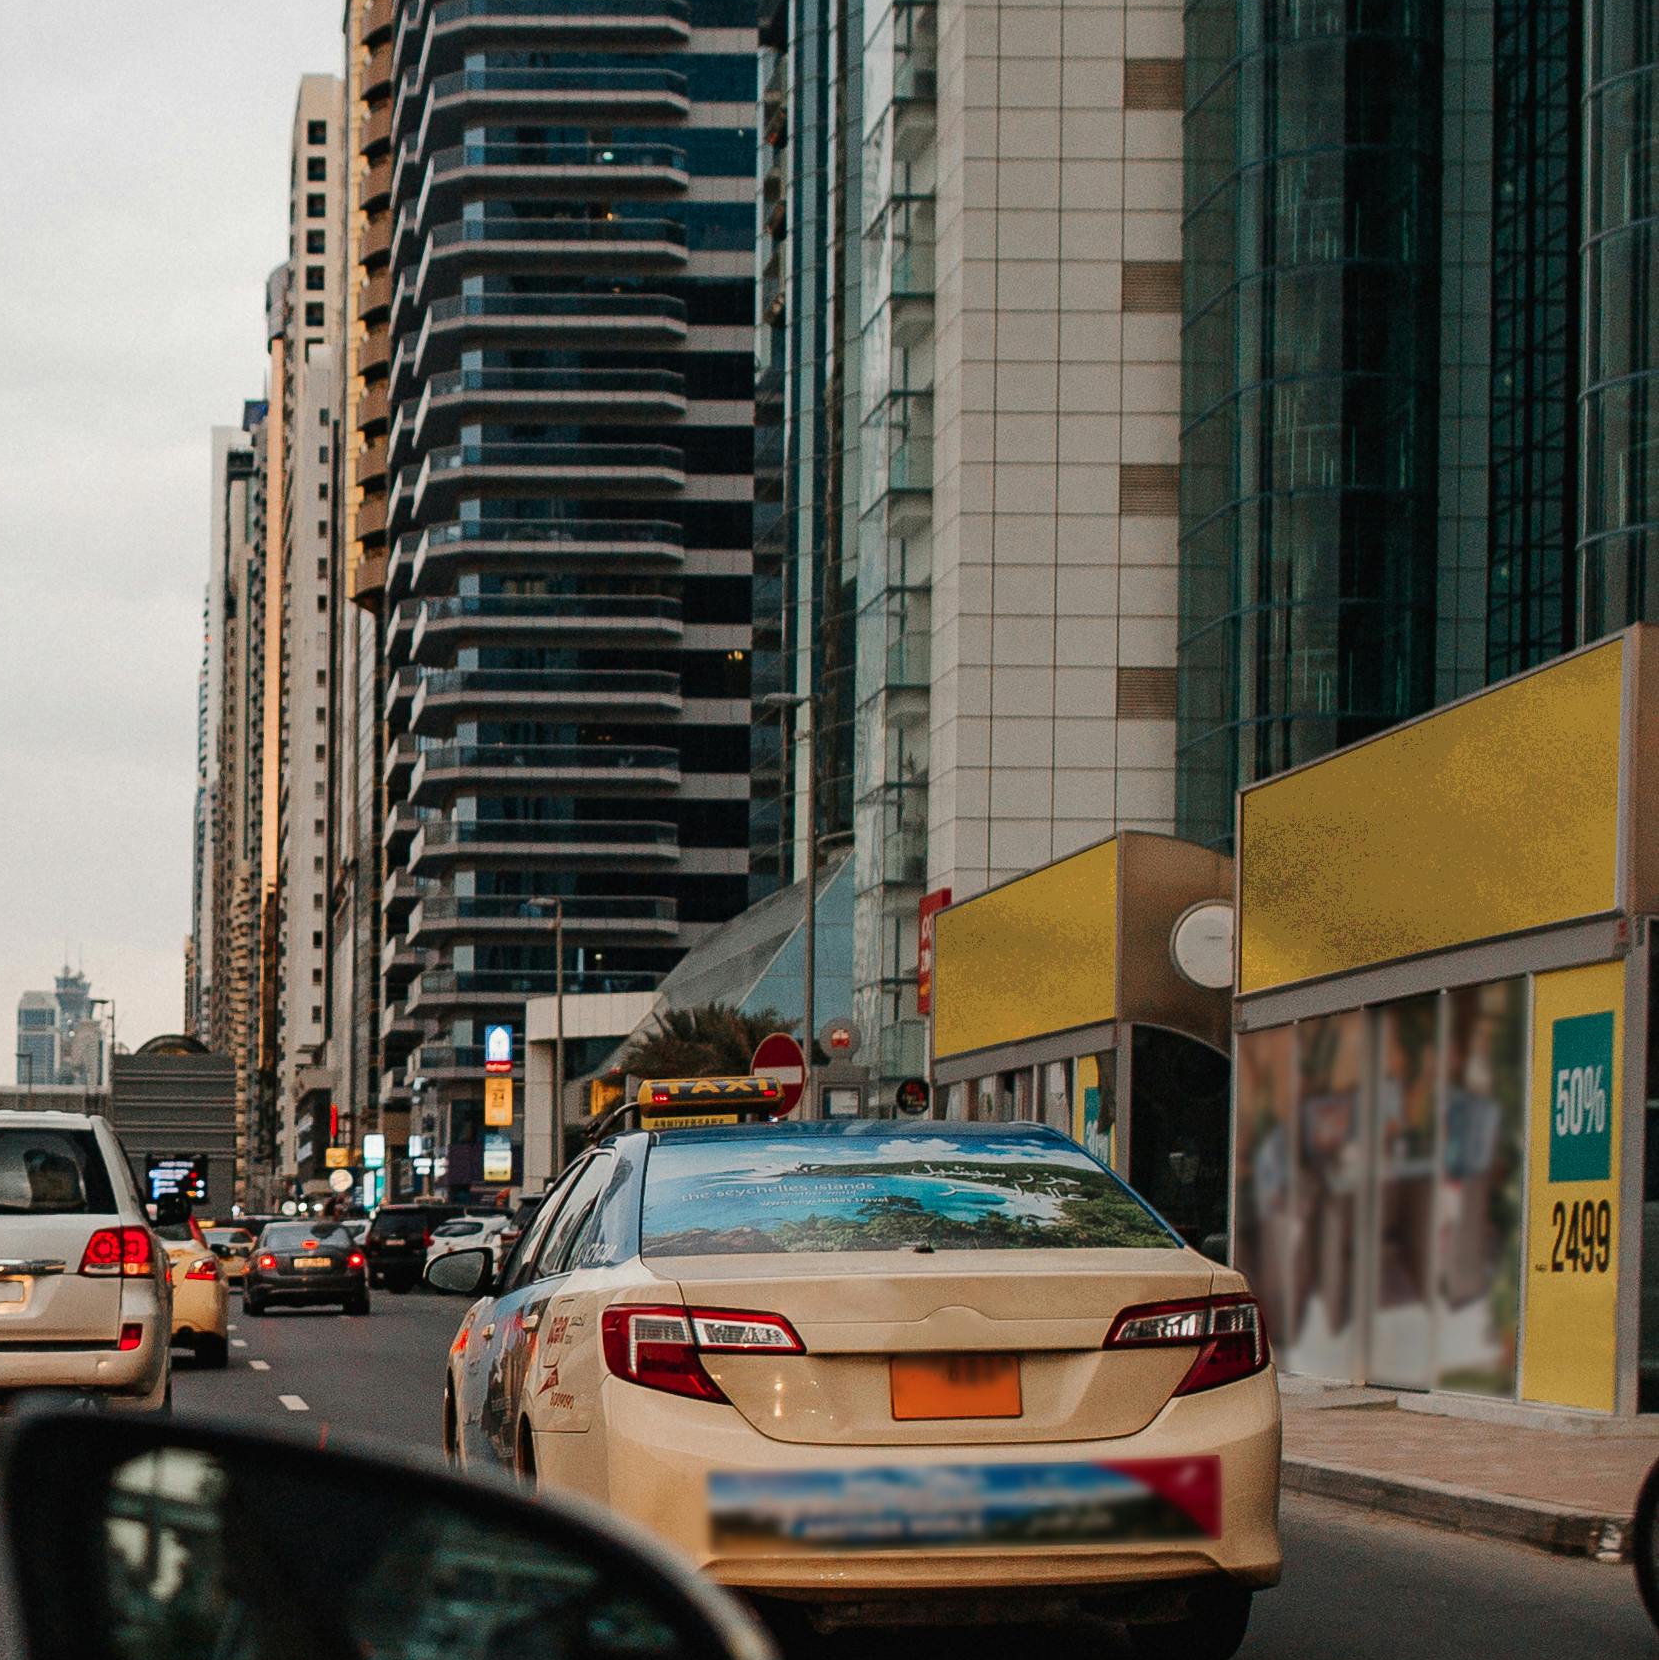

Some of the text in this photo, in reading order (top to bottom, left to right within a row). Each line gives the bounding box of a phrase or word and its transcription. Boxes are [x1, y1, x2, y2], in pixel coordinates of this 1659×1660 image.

[663, 1078, 769, 1094] TAXI
[1555, 1064, 1607, 1137] 50%
[681, 1181, 876, 1202] the seychelles islands
[1550, 1198, 1612, 1274] 2499
